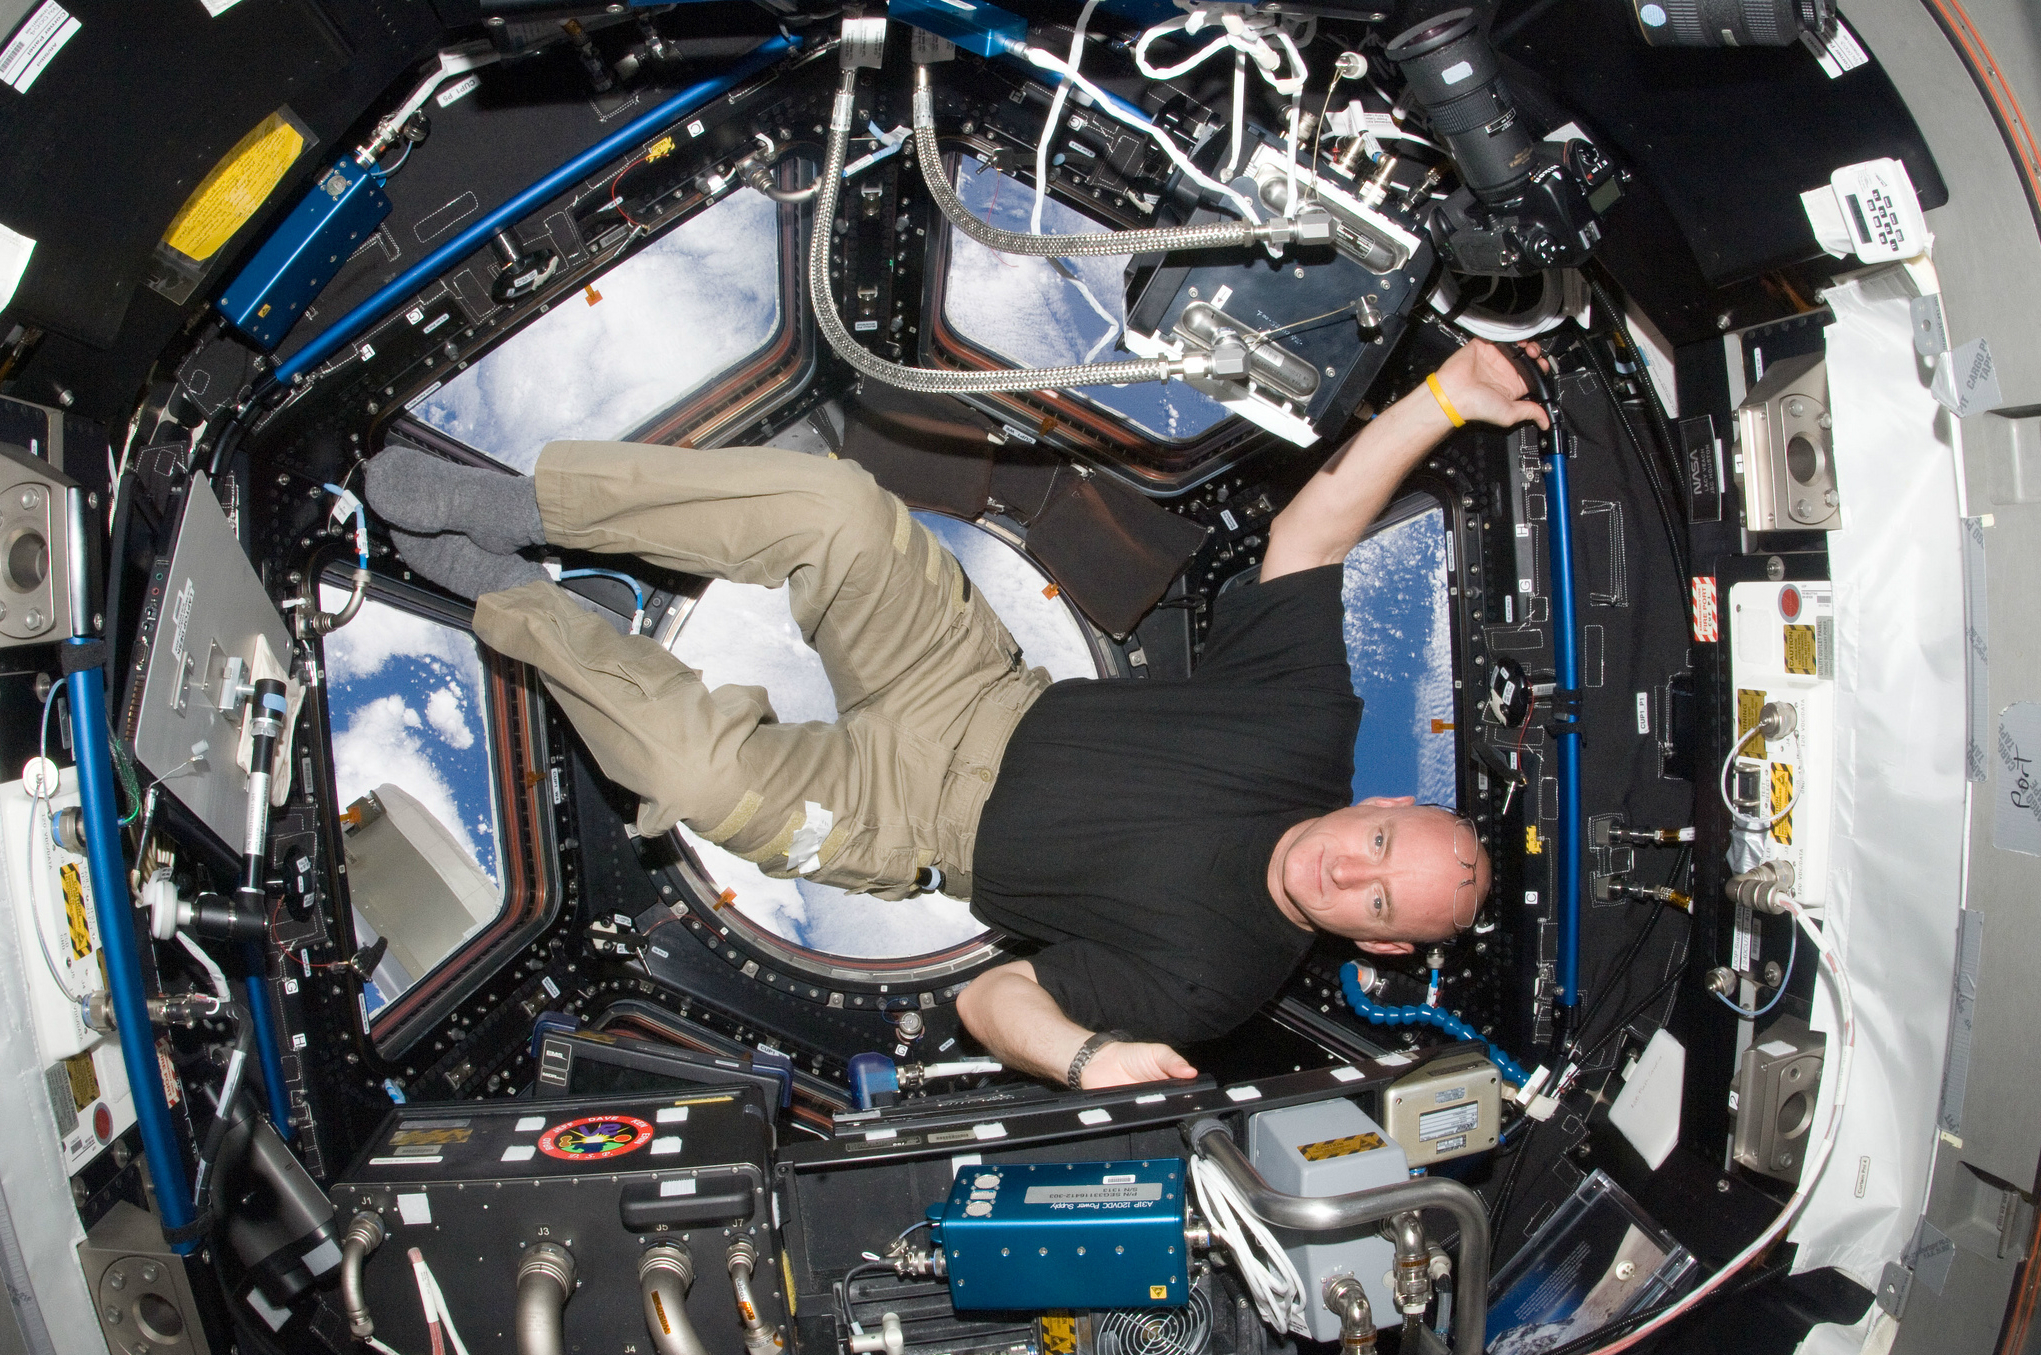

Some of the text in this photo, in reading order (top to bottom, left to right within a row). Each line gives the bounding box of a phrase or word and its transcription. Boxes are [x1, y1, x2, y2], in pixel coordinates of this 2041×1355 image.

[28, 12, 66, 55] Corner Panel
[1834, 48, 1851, 69] Corner
[690, 125, 703, 136] C
[1073, 119, 1081, 128] G
[408, 312, 421, 324] G
[1966, 353, 1984, 390] CARGO
[1700, 448, 1708, 472] VEACH
[1705, 444, 1715, 480] HOUSTON
[1689, 449, 1702, 494] NASA
[1517, 525, 1527, 536] H
[1520, 580, 1531, 592] G
[1999, 723, 2015, 752] TAPE
[2011, 744, 2032, 808] Port
[2026, 796, 2041, 822] ARGO
[44, 832, 53, 870] VDC/DATA
[74, 880, 82, 918] CAUTION
[1526, 893, 1537, 902] C
[288, 980, 297, 991] G
[73, 1005, 83, 1042] VDC/DATA
[295, 1036, 305, 1047] H
[897, 1046, 907, 1056] G
[159, 1050, 172, 1098] FIRE PORT
[1730, 1095, 1738, 1109] 2
[553, 1119, 648, 1134] JEFF KEN
[542, 1132, 651, 1151] BRAD ERIN
[1857, 1174, 1866, 1195] Curtain
[361, 1196, 372, 1206] J1
[1050, 1202, 1071, 1210] Supply
[1074, 1202, 1099, 1210] Power
[732, 1219, 743, 1229] J7
[537, 1228, 550, 1237] J3
[624, 1345, 636, 1355] J4
